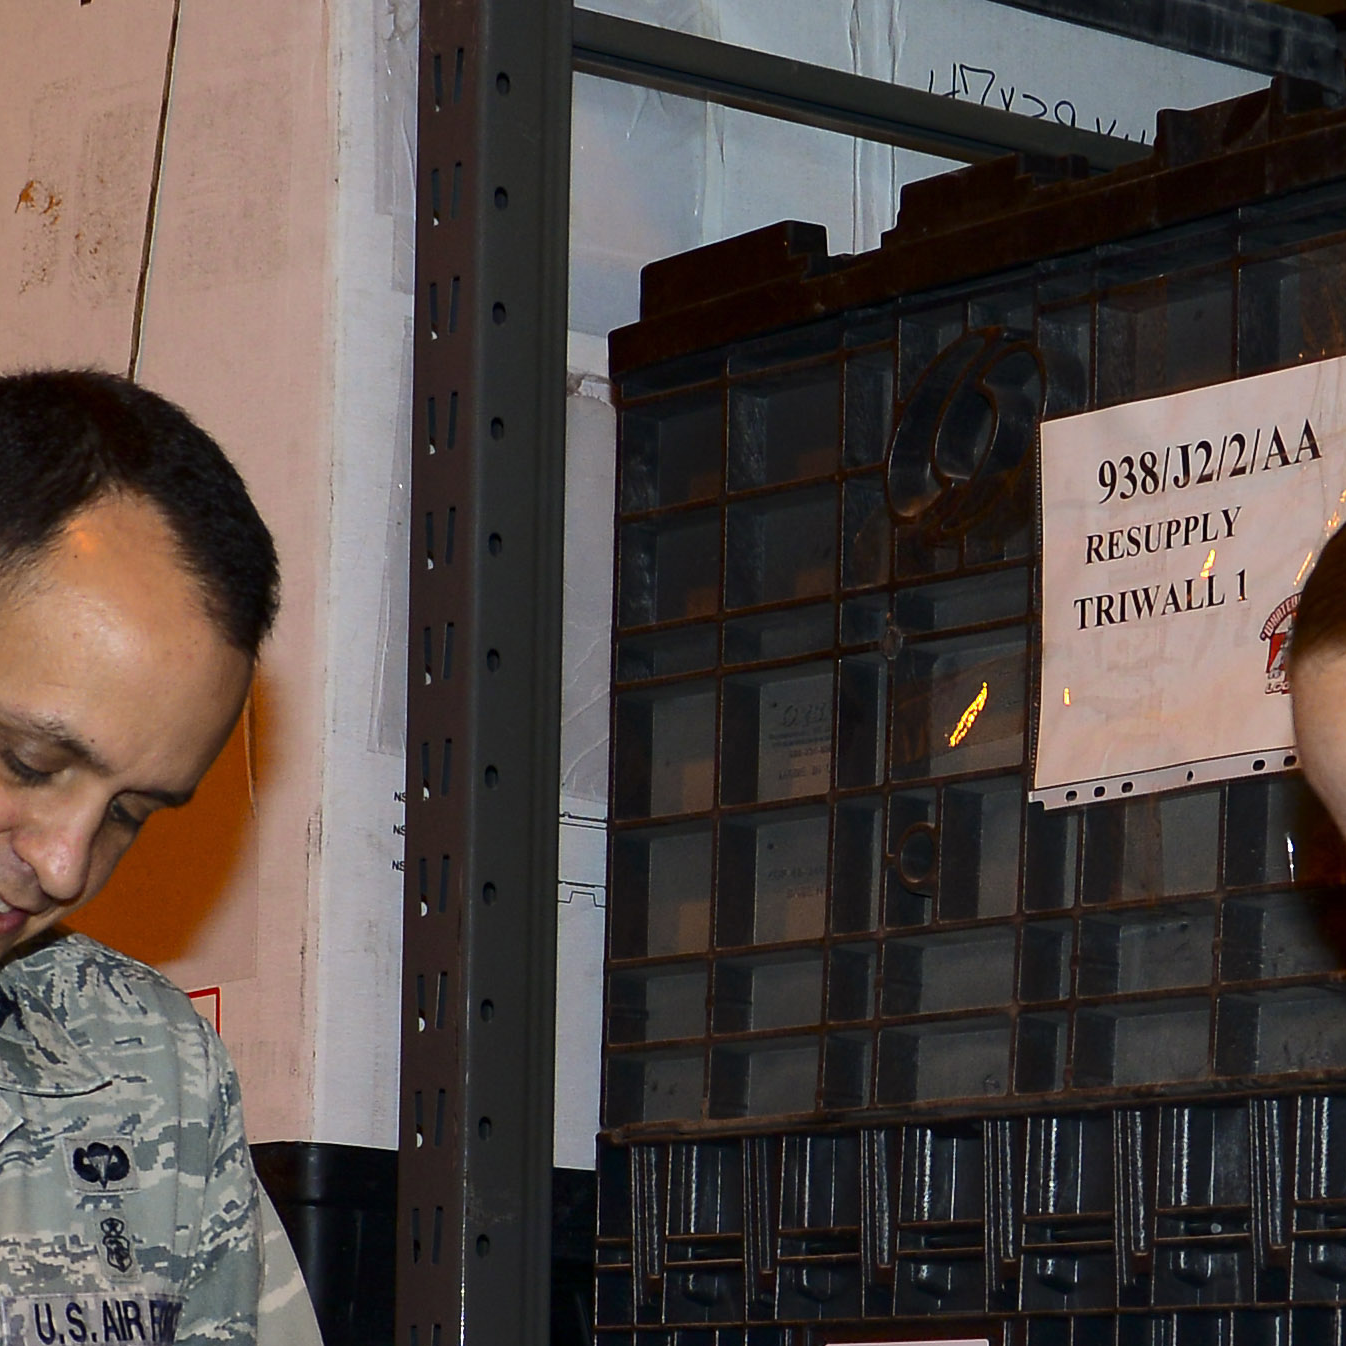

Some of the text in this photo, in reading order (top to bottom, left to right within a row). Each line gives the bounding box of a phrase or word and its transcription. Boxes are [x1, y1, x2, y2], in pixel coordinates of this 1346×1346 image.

[1098, 418, 1322, 504] 938/J2/2/AA
[1085, 506, 1241, 565] RESUPPLY
[1073, 568, 1247, 630] TRIWALL 1
[34, 1302, 97, 1345] U.S.
[103, 1300, 145, 1342] AIR
